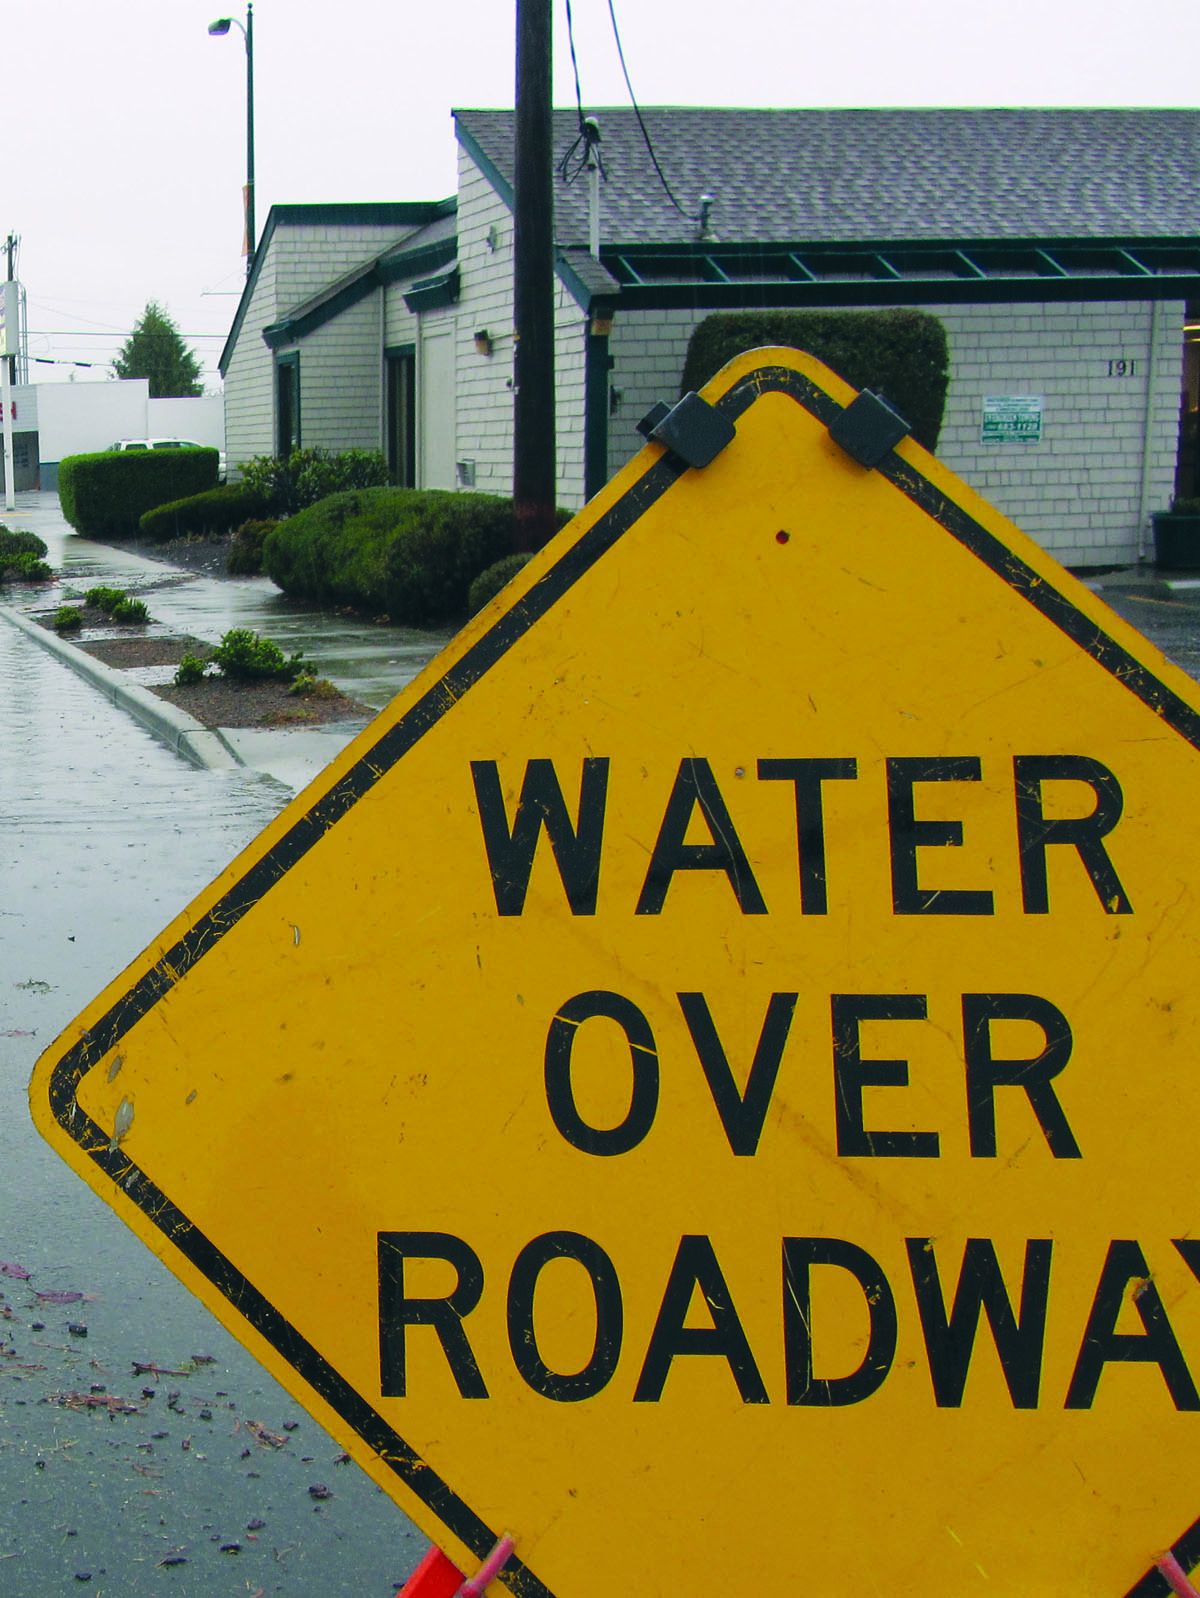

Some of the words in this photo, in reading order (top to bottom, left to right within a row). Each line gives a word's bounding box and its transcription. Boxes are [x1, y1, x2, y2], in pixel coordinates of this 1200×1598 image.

[1108, 359, 1135, 377] 191
[469, 754, 1135, 917] WATER
[543, 989, 1084, 1160] OVER
